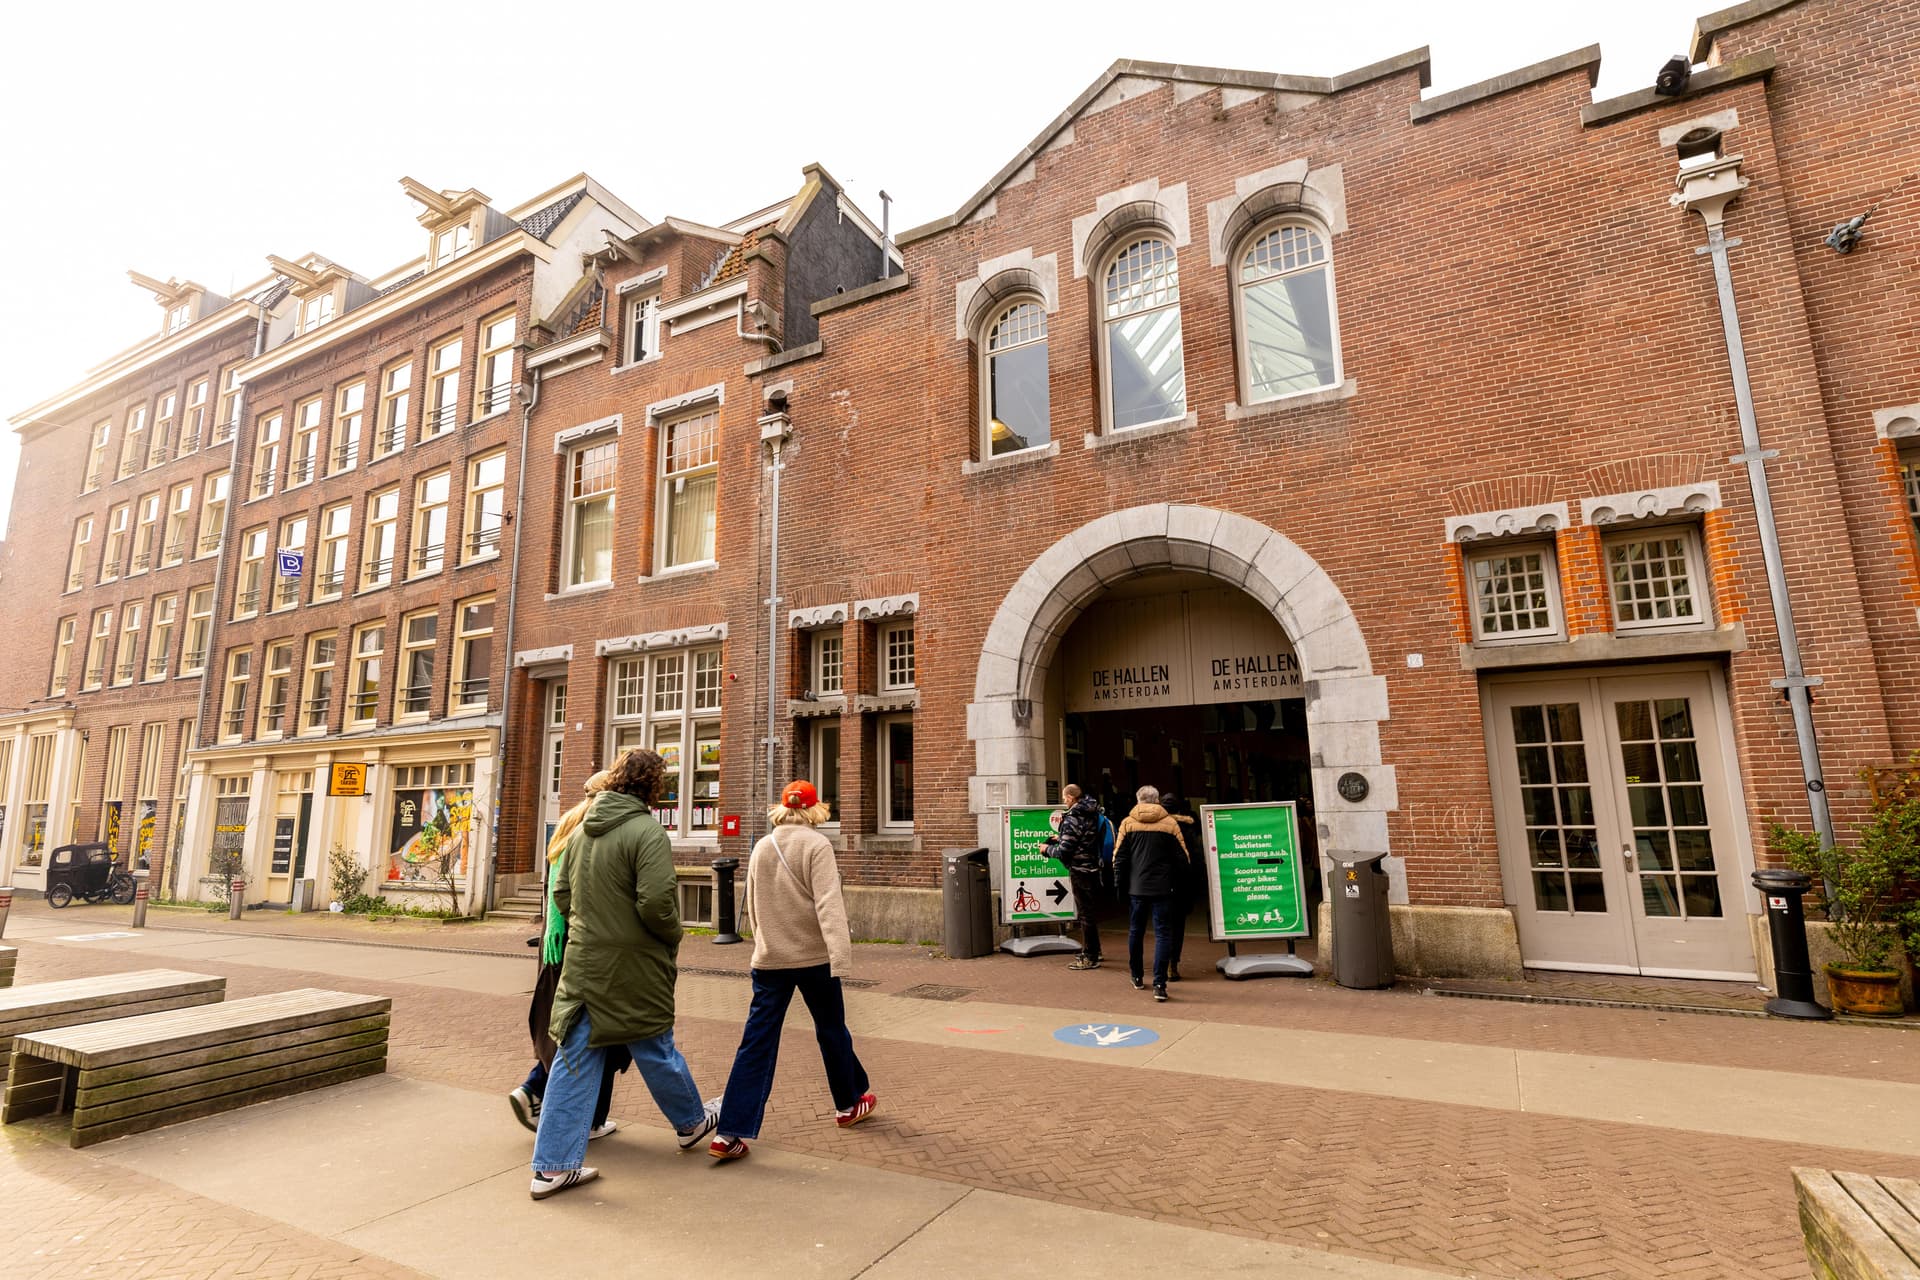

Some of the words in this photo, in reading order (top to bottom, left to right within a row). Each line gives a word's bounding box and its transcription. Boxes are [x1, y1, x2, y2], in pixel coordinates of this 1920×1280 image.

[1212, 659, 1230, 676] DE
[1235, 652, 1299, 675] HALLEN
[1093, 670, 1110, 687] DE
[1113, 664, 1169, 685] HALLEN
[1213, 673, 1300, 691] AMSTERDAM
[1094, 684, 1170, 700] AMSTERDAM
[1013, 828, 1054, 838] Entrance
[1232, 833, 1262, 841] Scooters
[1013, 840, 1041, 851] bicycl
[1014, 852, 1049, 863] parking
[1220, 850, 1244, 858] andere
[1245, 850, 1268, 858] ingang
[1270, 848, 1288, 856] a.u.b.
[1014, 866, 1027, 875] De
[1029, 865, 1057, 875] Hallen
[1234, 867, 1263, 875] Scooters
[1237, 876, 1256, 884] cargo
[1246, 893, 1270, 901] please.
